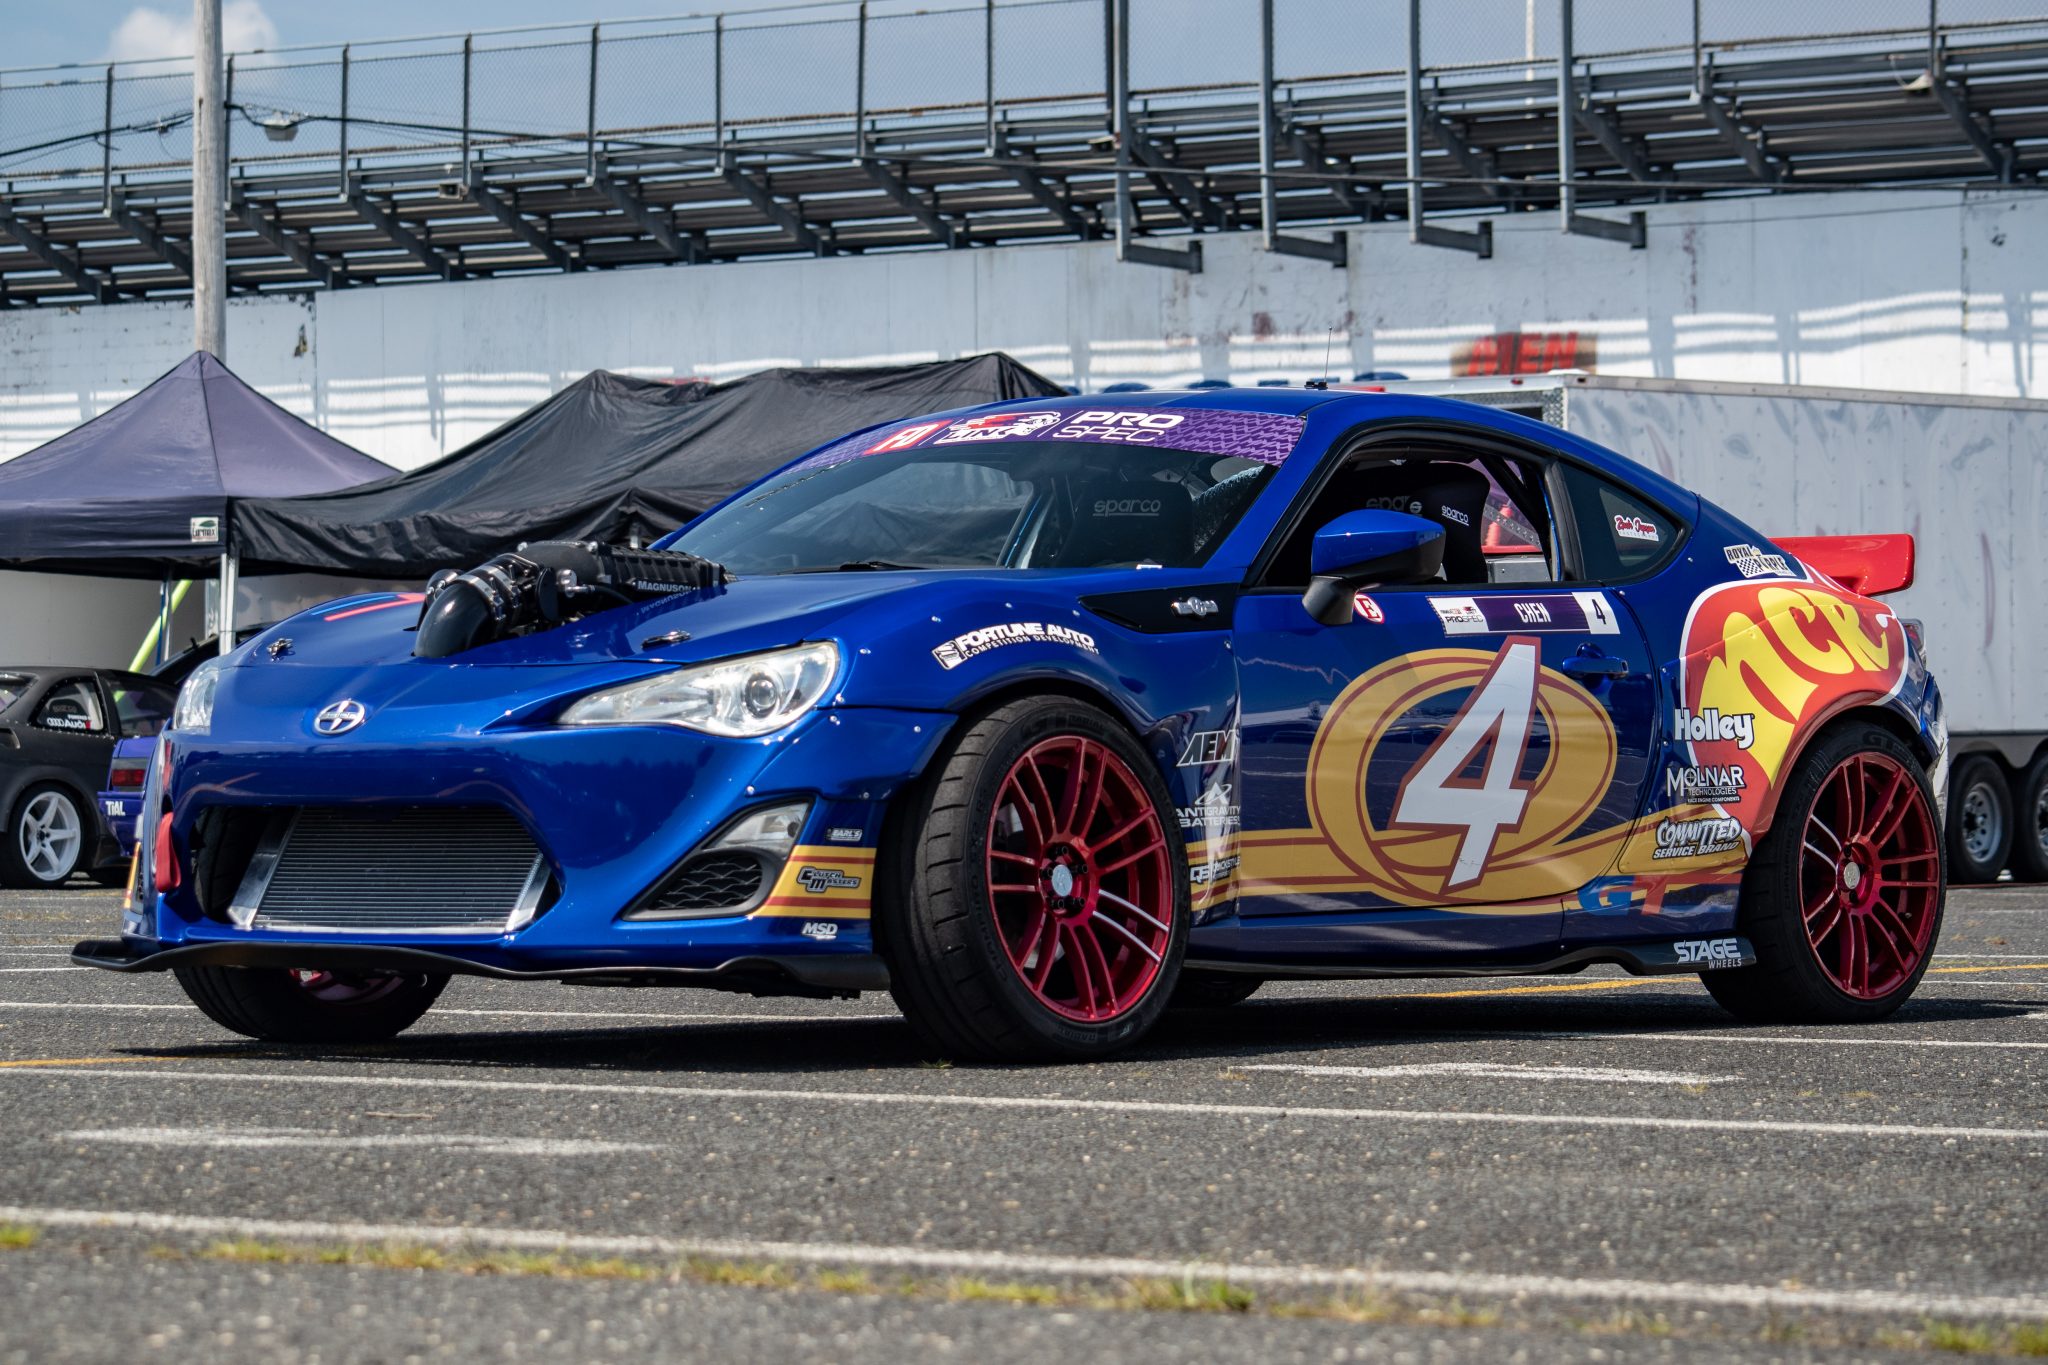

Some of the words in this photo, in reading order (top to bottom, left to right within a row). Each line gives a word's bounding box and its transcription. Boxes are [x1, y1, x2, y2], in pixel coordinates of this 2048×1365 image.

[1070, 411, 1185, 429] PRO
[1052, 425, 1165, 442] SPEC
[1093, 499, 1161, 517] sparco
[1441, 504, 1470, 525] sparco
[637, 580, 692, 593] MAGNUSON
[1356, 597, 1381, 619] E
[1514, 602, 1552, 624] CHEN
[1592, 598, 1607, 625] 4
[955, 622, 1046, 651] FORTUNE
[1047, 623, 1095, 647] AUTO
[965, 635, 1031, 658] COMPETITION
[1033, 634, 1100, 655] DEVELOPMENT
[1674, 707, 1755, 750] Holley
[1176, 729, 1238, 767] AEM
[1392, 638, 1540, 892] 4
[1667, 766, 1745, 797] MOLNAR
[1689, 787, 1737, 796] TECHNOLOGIES
[1176, 805, 1241, 818] ANTIGRAVITY
[1656, 817, 1742, 850] COMMITTED
[1653, 845, 1696, 859] SERVICE
[1698, 841, 1740, 855] BRAND
[802, 922, 838, 936] MSD
[1674, 938, 1742, 964] STAGE
[1708, 958, 1743, 969] WHEELS
